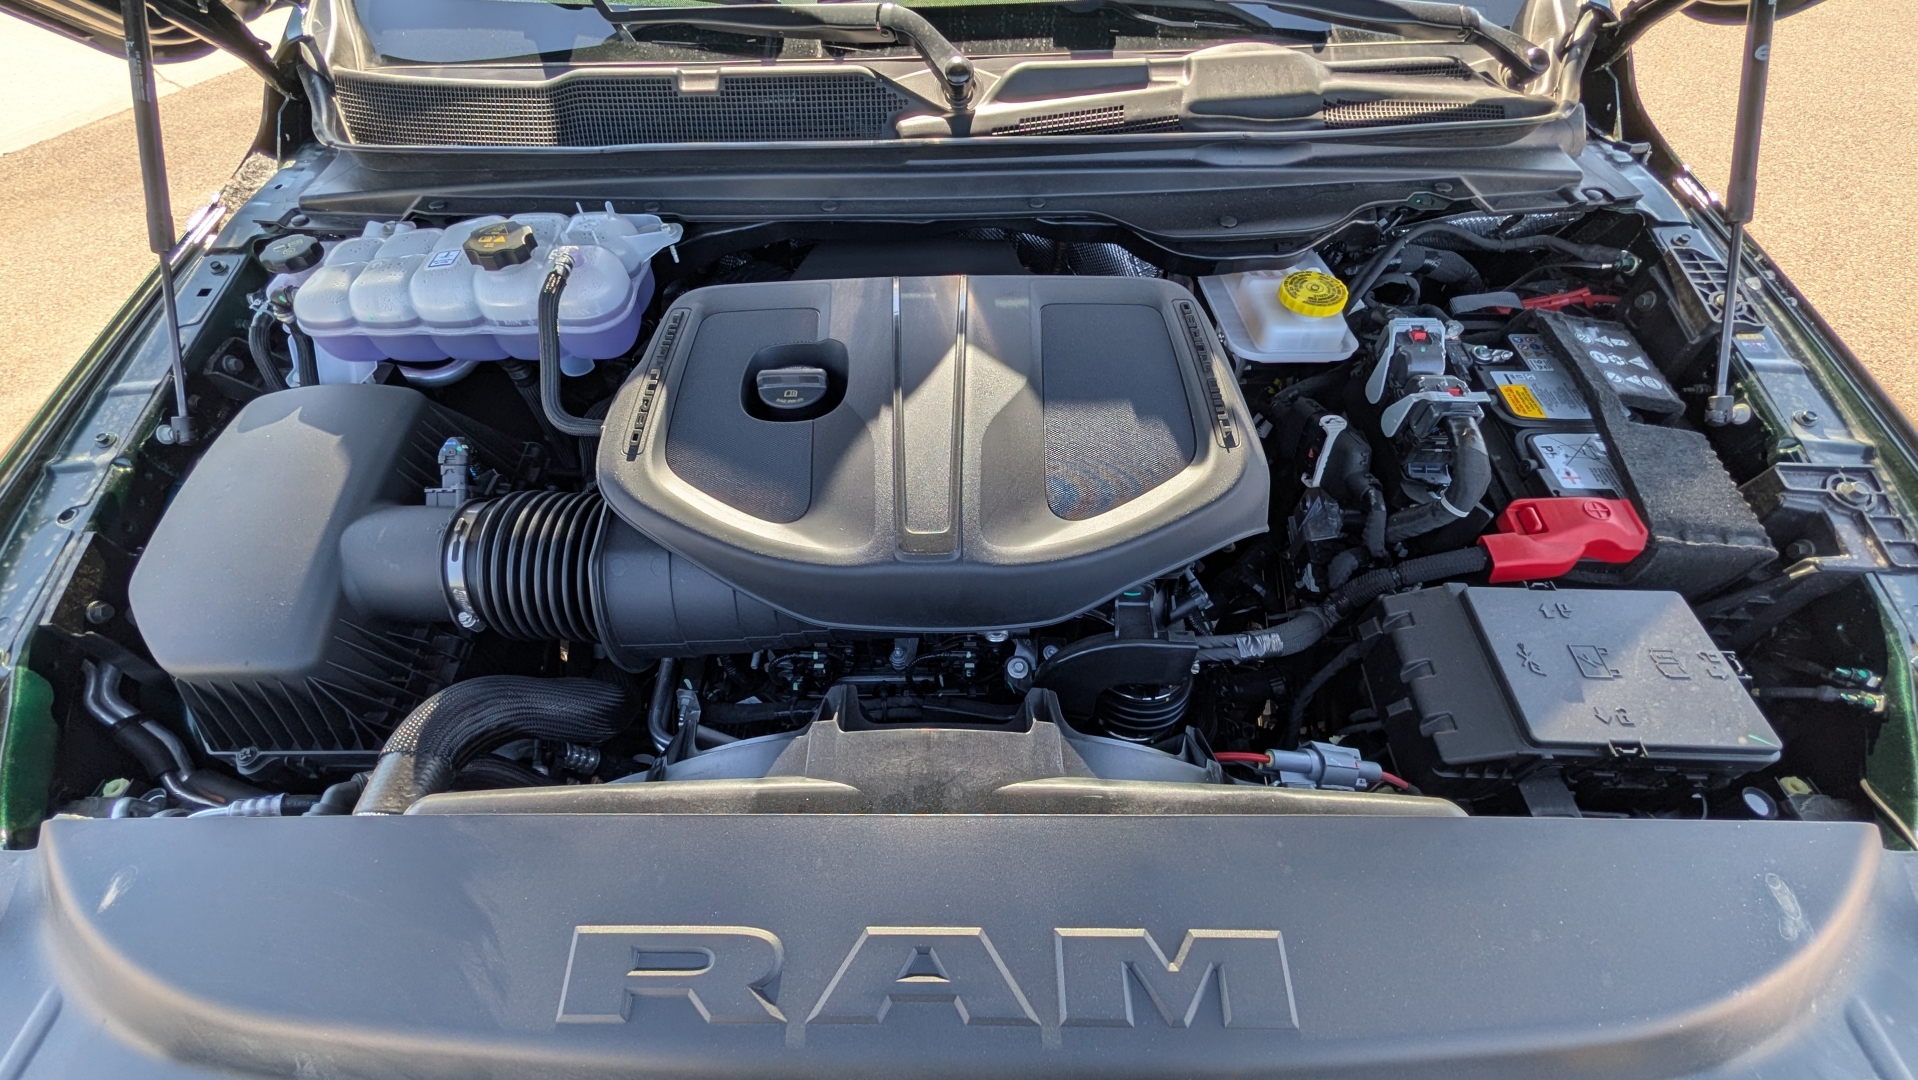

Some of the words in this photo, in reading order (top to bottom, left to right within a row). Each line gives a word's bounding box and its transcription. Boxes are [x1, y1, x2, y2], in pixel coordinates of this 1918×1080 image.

[657, 312, 683, 358] TWIN
[1180, 302, 1211, 372] TURBO
[630, 368, 661, 446] TURBO
[1207, 378, 1233, 438] TWIN
[556, 925, 1299, 1028] RAM
